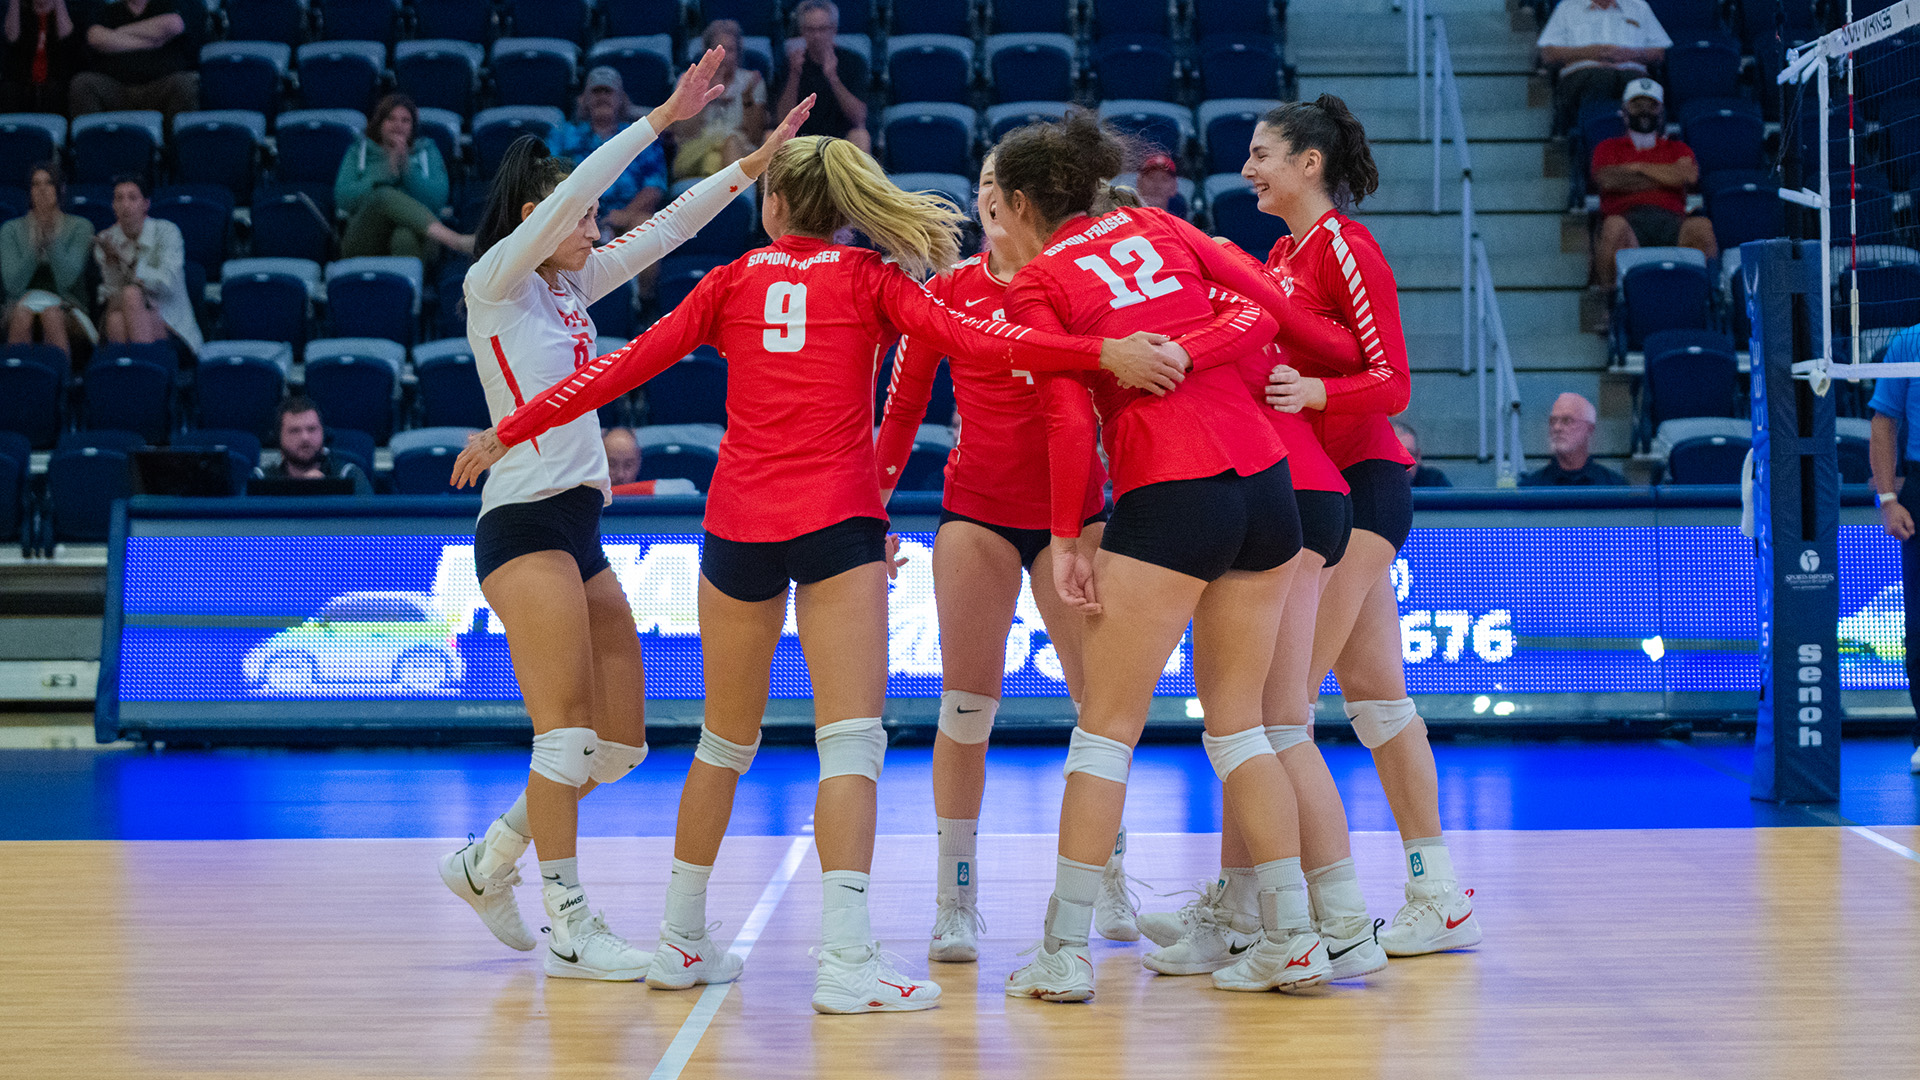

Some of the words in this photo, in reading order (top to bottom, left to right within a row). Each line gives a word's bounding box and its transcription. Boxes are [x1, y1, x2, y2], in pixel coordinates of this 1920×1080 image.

[1043, 234, 1088, 257] SIMON
[1084, 211, 1133, 240] FRASER
[747, 252, 790, 268] SIMON
[790, 251, 841, 271] FRASER
[1073, 235, 1184, 310] 12
[763, 281, 807, 353] 9
[559, 894, 584, 912] ZAMST
